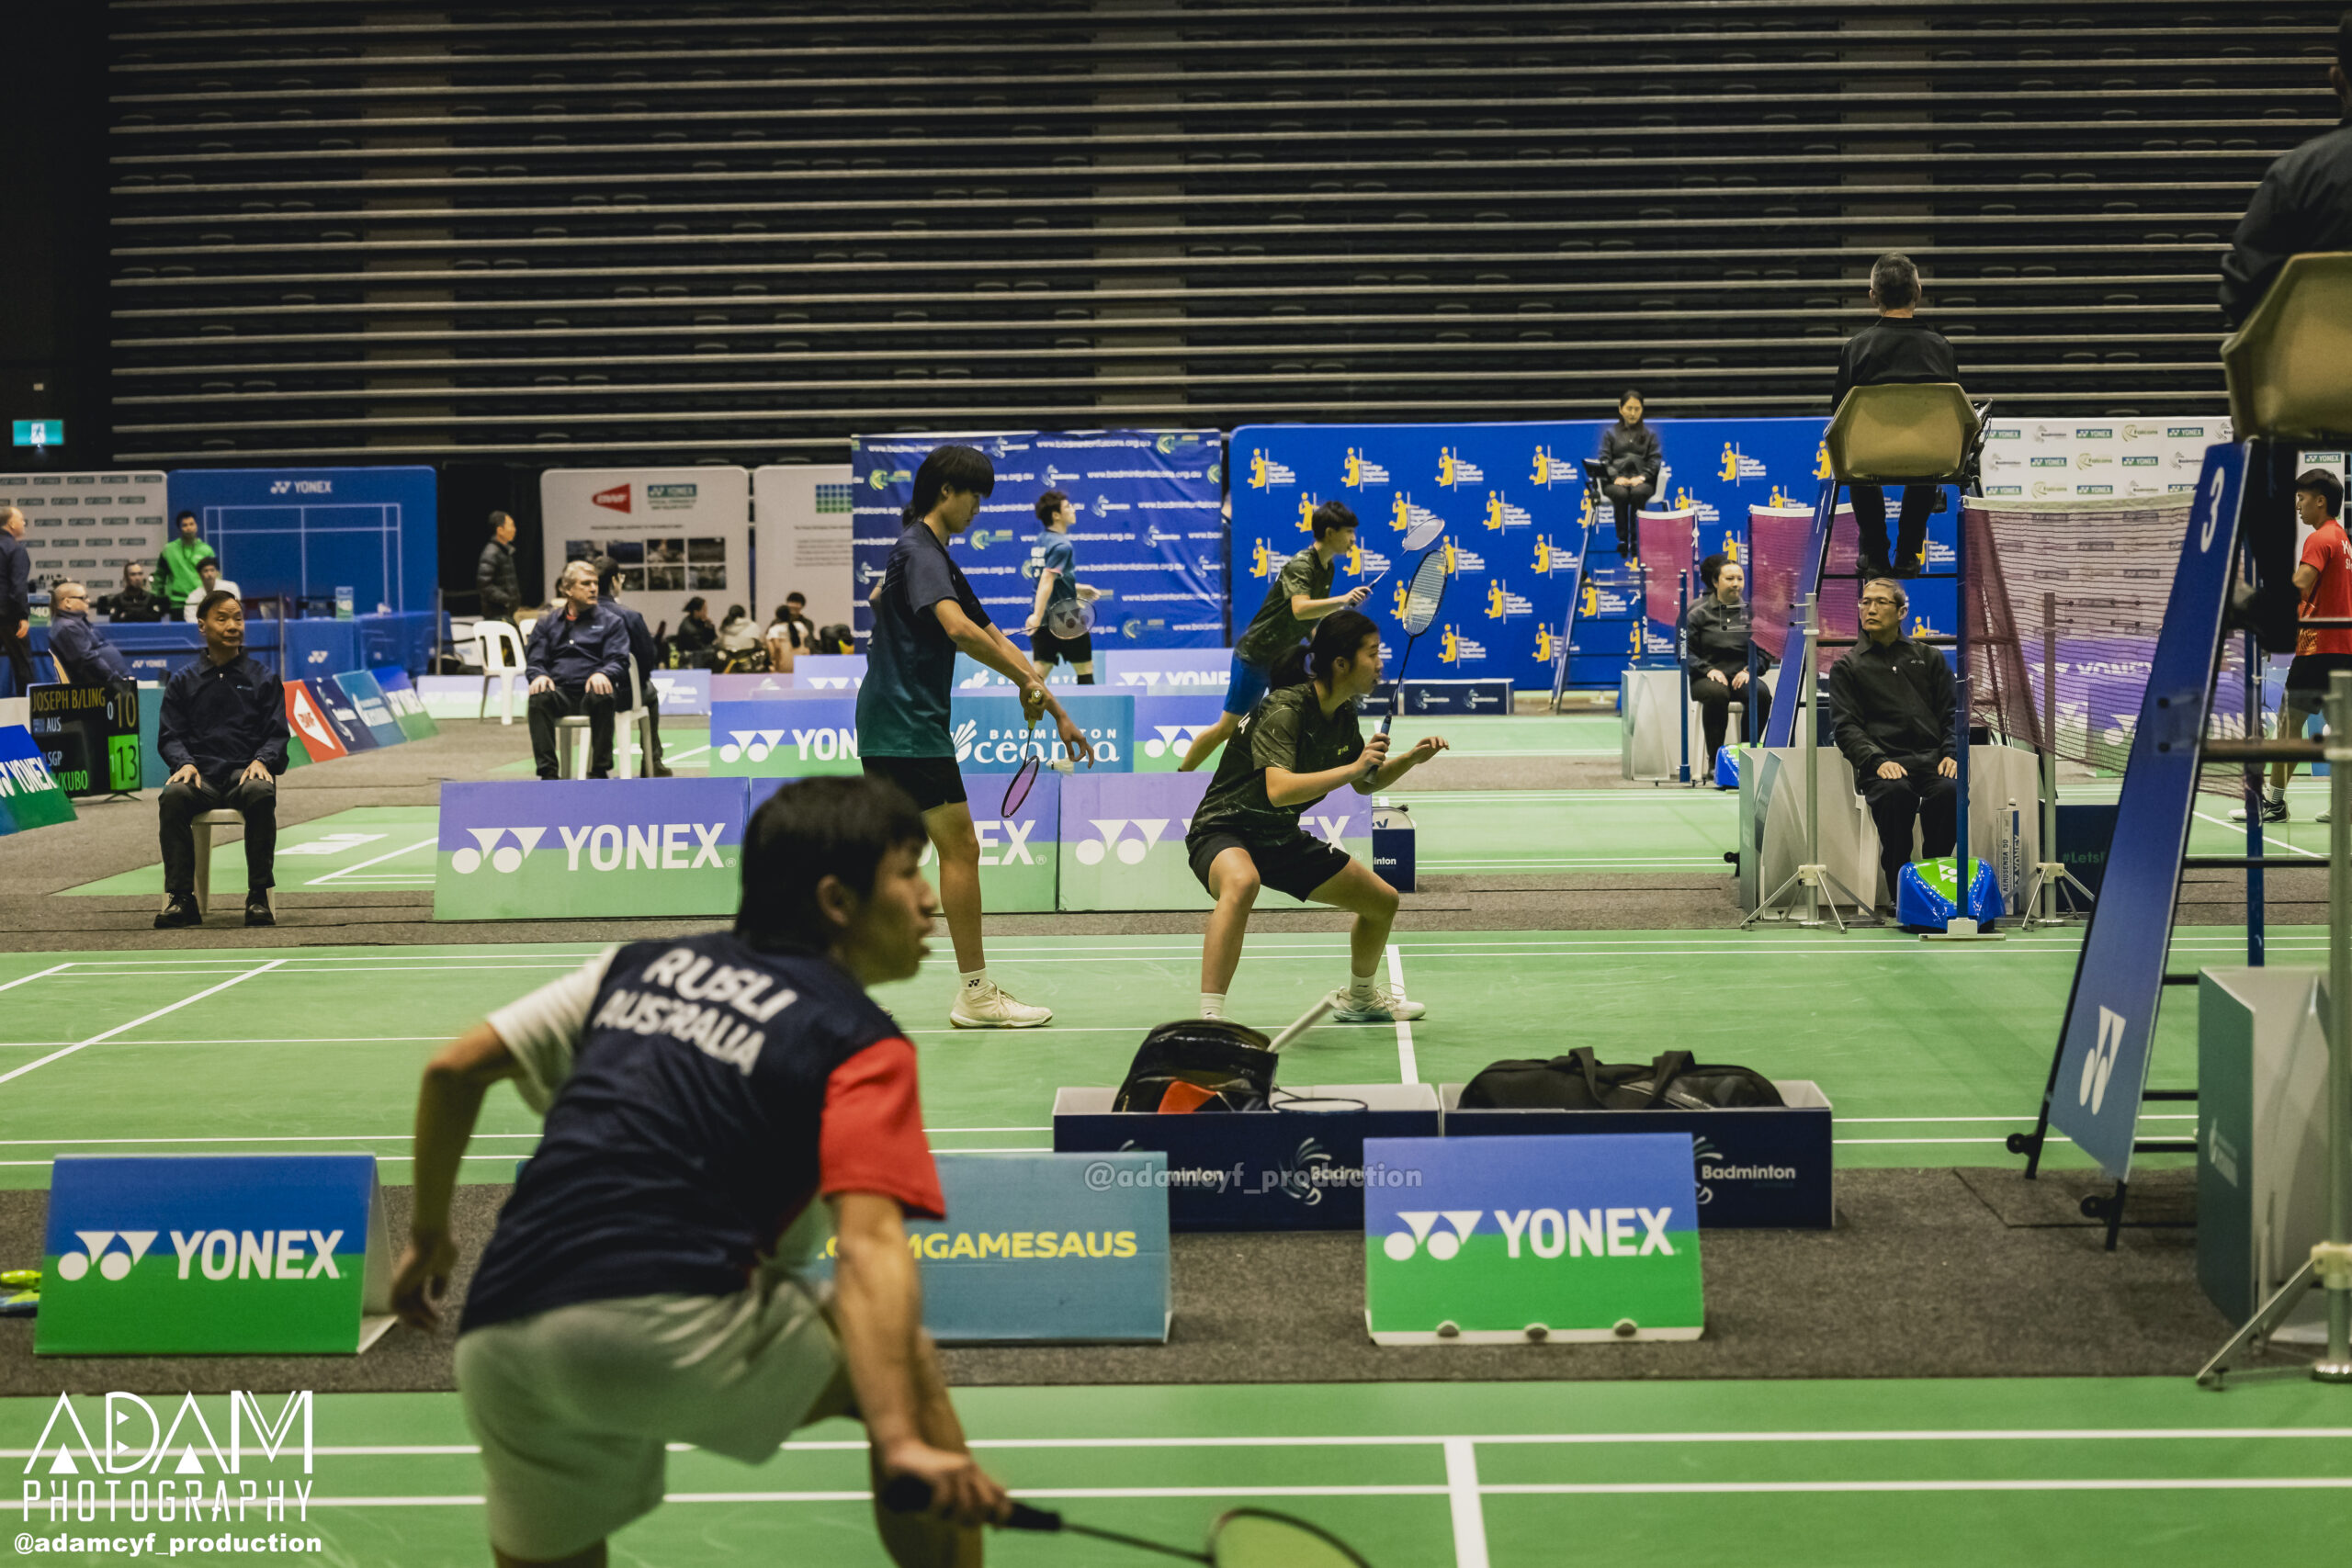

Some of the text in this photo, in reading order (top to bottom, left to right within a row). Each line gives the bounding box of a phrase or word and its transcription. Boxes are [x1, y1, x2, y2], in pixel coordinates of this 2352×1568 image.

[2090, 430, 2111, 438] YONEX
[2181, 428, 2201, 436] YONEX
[2044, 458, 2065, 467] YONEX
[2136, 457, 2157, 466] YONEX
[294, 480, 333, 494] YONEX
[2200, 467, 2225, 553] 3
[32, 687, 107, 712] JOSEPH B/LING
[107, 701, 114, 720] 0
[115, 691, 138, 728] 10
[46, 716, 62, 732] AUS
[989, 728, 1117, 739] BADMION
[792, 728, 858, 761] YON
[47, 750, 62, 766] SGP
[116, 744, 138, 782] 13
[6, 756, 58, 794] YONEX
[558, 822, 726, 872] YONEX
[641, 948, 798, 1023] RUSLI
[1702, 1164, 1796, 1180] Badminton
[1493, 1206, 1675, 1259] YONEX
[170, 1229, 345, 1281] YONEX
